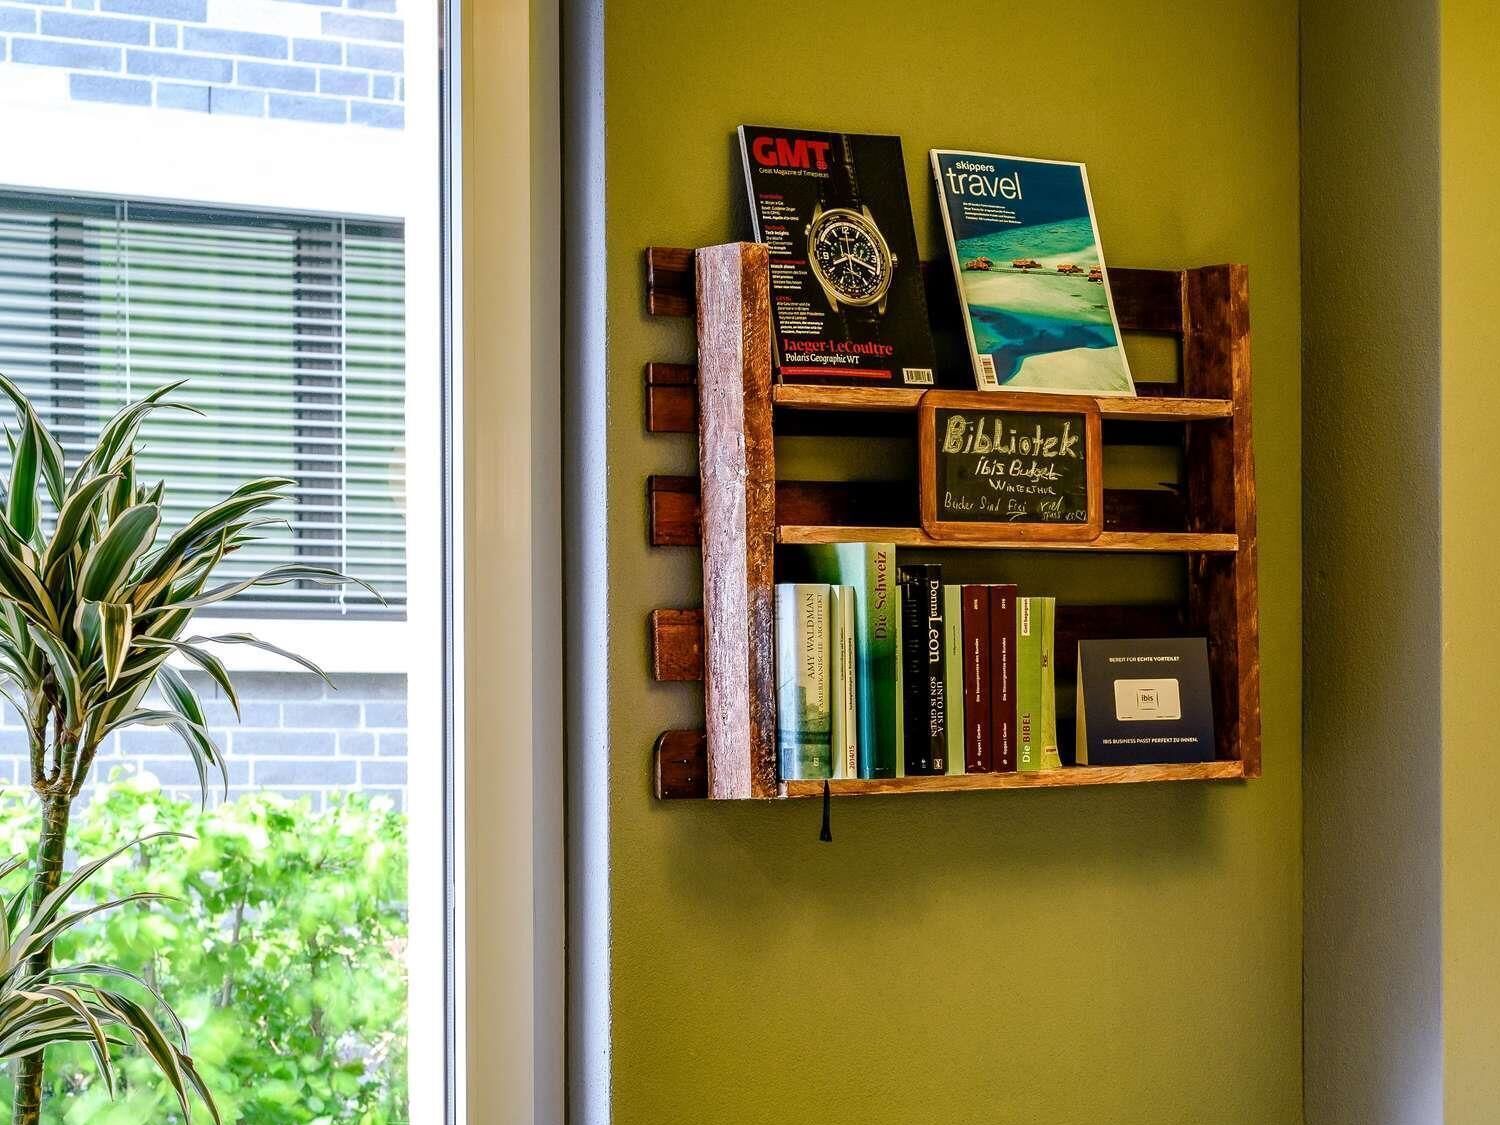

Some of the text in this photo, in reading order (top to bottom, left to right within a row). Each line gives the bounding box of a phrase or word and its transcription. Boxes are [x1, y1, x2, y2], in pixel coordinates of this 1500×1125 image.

[753, 136, 829, 169] GMT
[773, 168, 796, 176] Magazine
[955, 160, 995, 173] skippers
[946, 167, 1022, 200] travel
[783, 338, 894, 356] Jaeger-LeCoultre
[785, 352, 860, 365] Polaris Geographic WT
[1009, 459, 1063, 482] Budget
[873, 551, 888, 640] Die Schweiz
[928, 580, 943, 664] Donna Leon
[806, 592, 815, 680] AMY WALDMAN
[930, 698, 937, 706] IS
[1141, 694, 1154, 702] ibis
[937, 712, 944, 724] US
[1022, 713, 1031, 763] Die BIBEL
[848, 745, 856, 770] 2014/15
